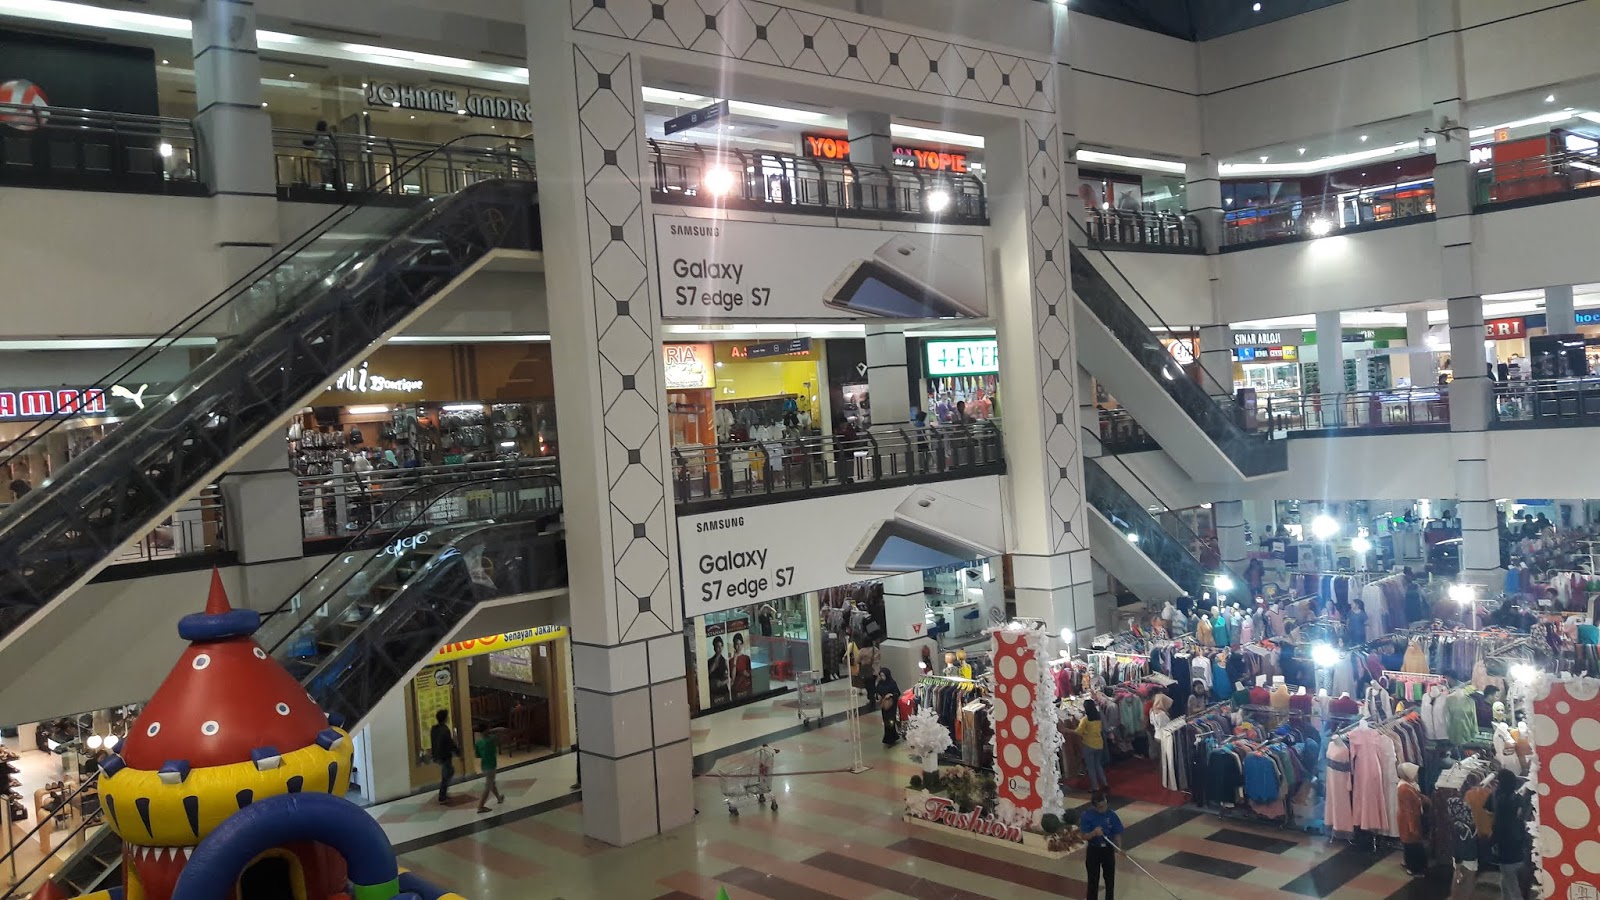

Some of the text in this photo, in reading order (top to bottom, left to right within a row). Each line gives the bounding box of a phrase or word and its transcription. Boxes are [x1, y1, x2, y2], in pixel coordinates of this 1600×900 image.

[913, 149, 967, 174] YOPIE
[670, 224, 720, 238] SAMSUNG
[673, 258, 743, 285] Galaxy
[676, 285, 771, 312] S7 edge S7
[1234, 332, 1281, 346] SINAR ARLOJI
[696, 516, 744, 533] SAMSUNG
[699, 548, 768, 575] Galaxy
[701, 566, 795, 602] S7 edge S7
[503, 629, 533, 642] Senayan
[923, 796, 1022, 843] Fashion
